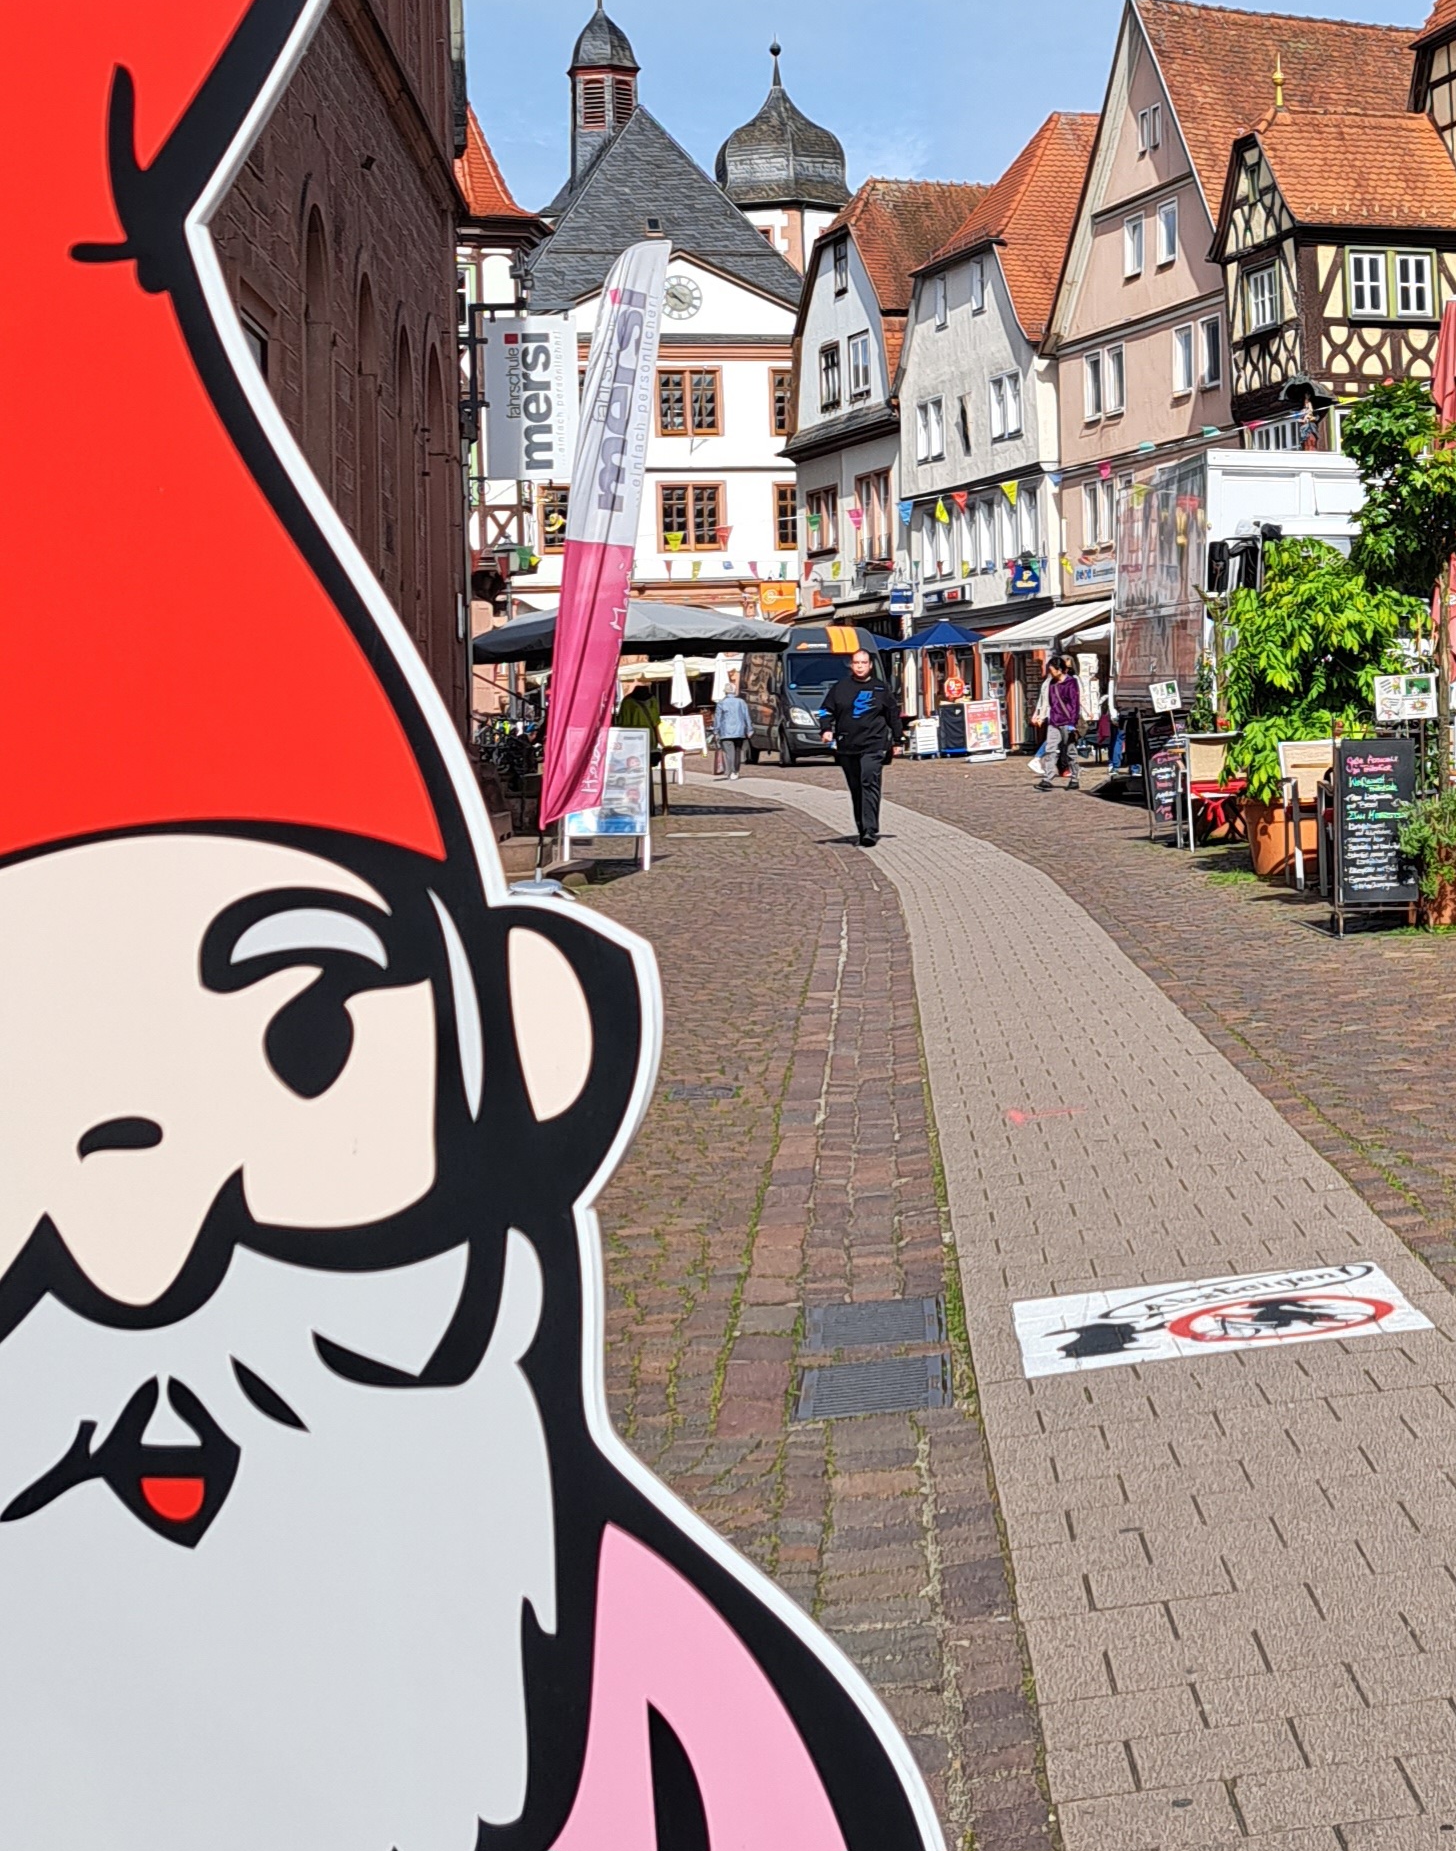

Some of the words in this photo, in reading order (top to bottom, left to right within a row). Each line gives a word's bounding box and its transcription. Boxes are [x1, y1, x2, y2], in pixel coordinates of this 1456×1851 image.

[505, 347, 521, 420] fahrschule
[520, 332, 554, 471] mersi
[598, 288, 647, 513] mersi
